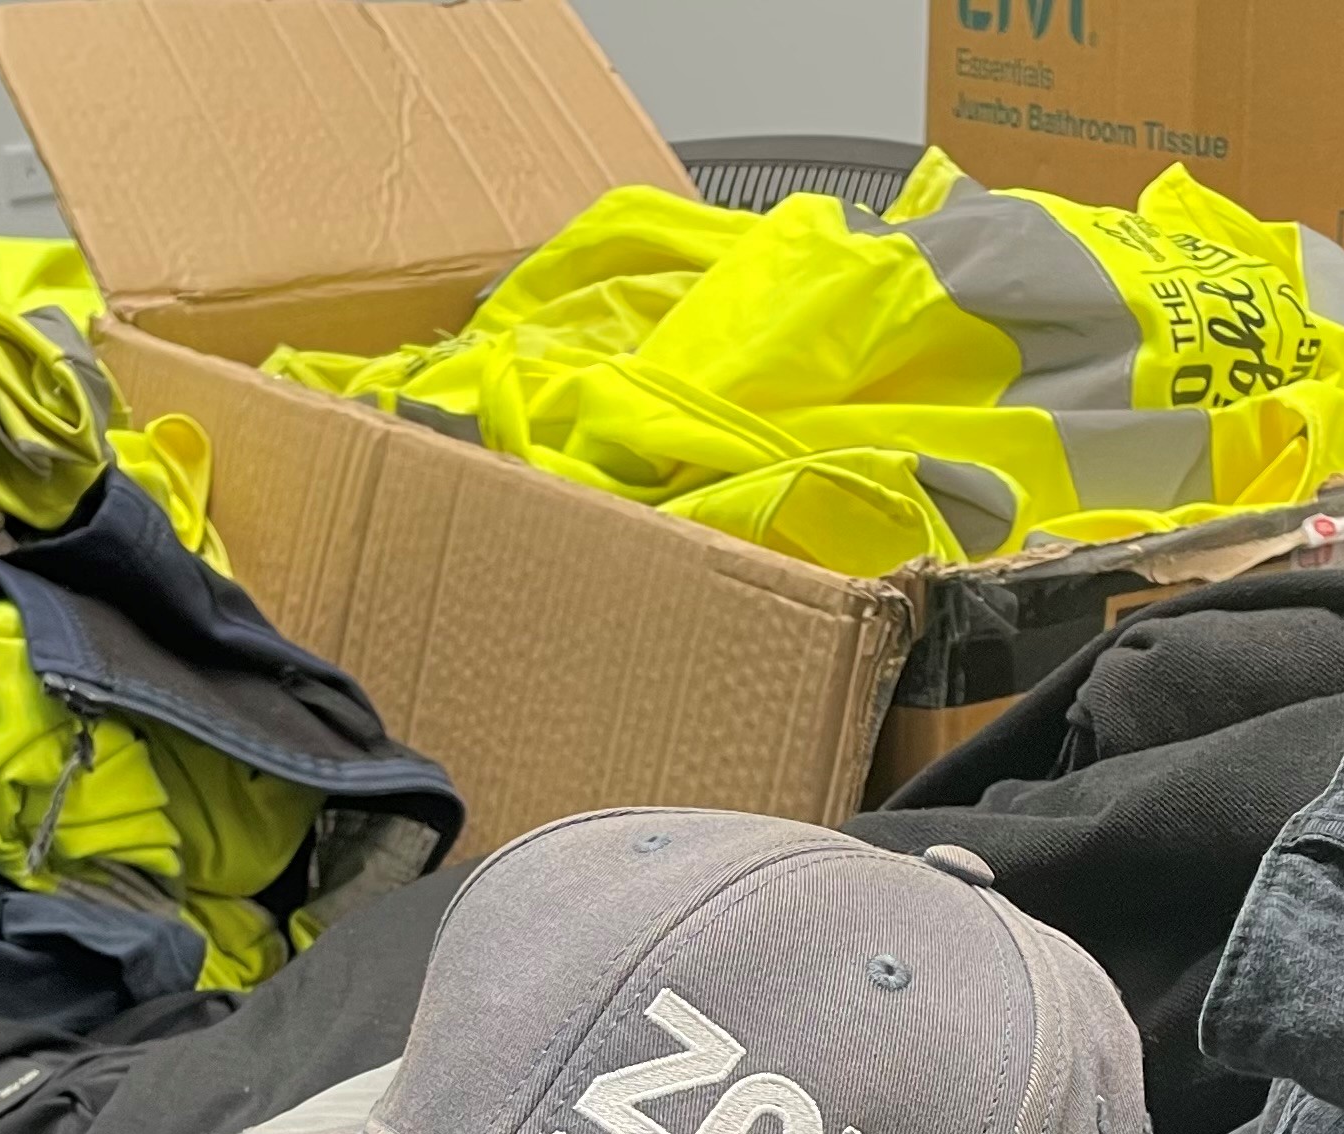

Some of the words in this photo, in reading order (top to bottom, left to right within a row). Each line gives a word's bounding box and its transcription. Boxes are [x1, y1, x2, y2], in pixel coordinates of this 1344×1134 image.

[956, 47, 1055, 90] Essentials
[952, 93, 1022, 128] Jumbo
[1028, 103, 1137, 148] Bathroom
[1143, 121, 1229, 159] Tissue
[1151, 277, 1196, 354] THE
